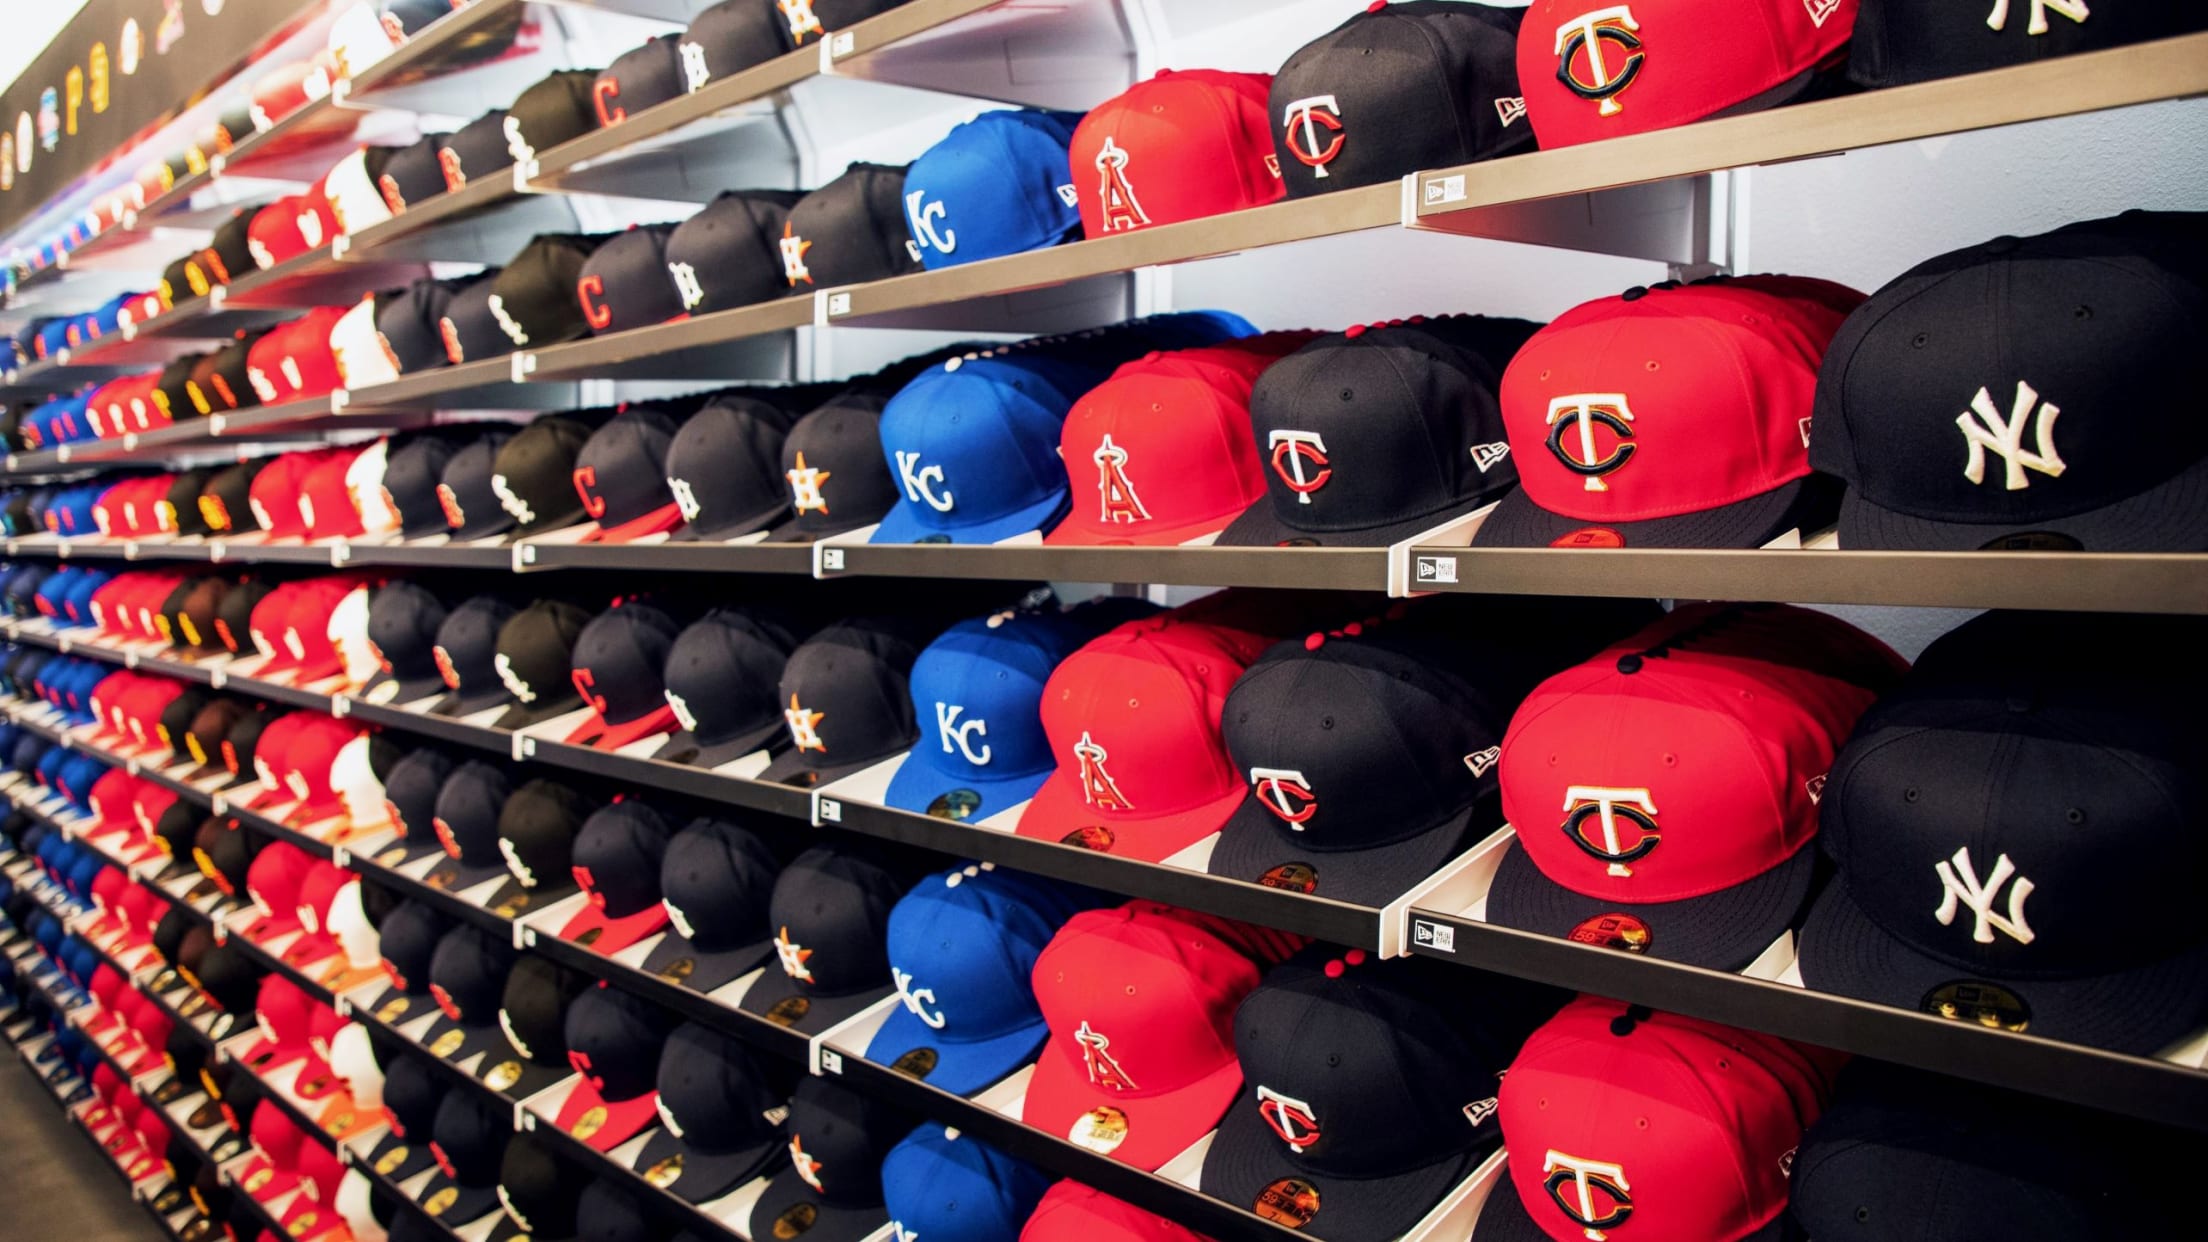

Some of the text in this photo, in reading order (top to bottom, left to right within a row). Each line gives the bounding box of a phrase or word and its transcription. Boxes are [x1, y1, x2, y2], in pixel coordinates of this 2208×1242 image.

[1956, 380, 2067, 490] NY
[896, 451, 953, 512] KC
[935, 702, 991, 766] KC
[1935, 846, 2035, 944] NY
